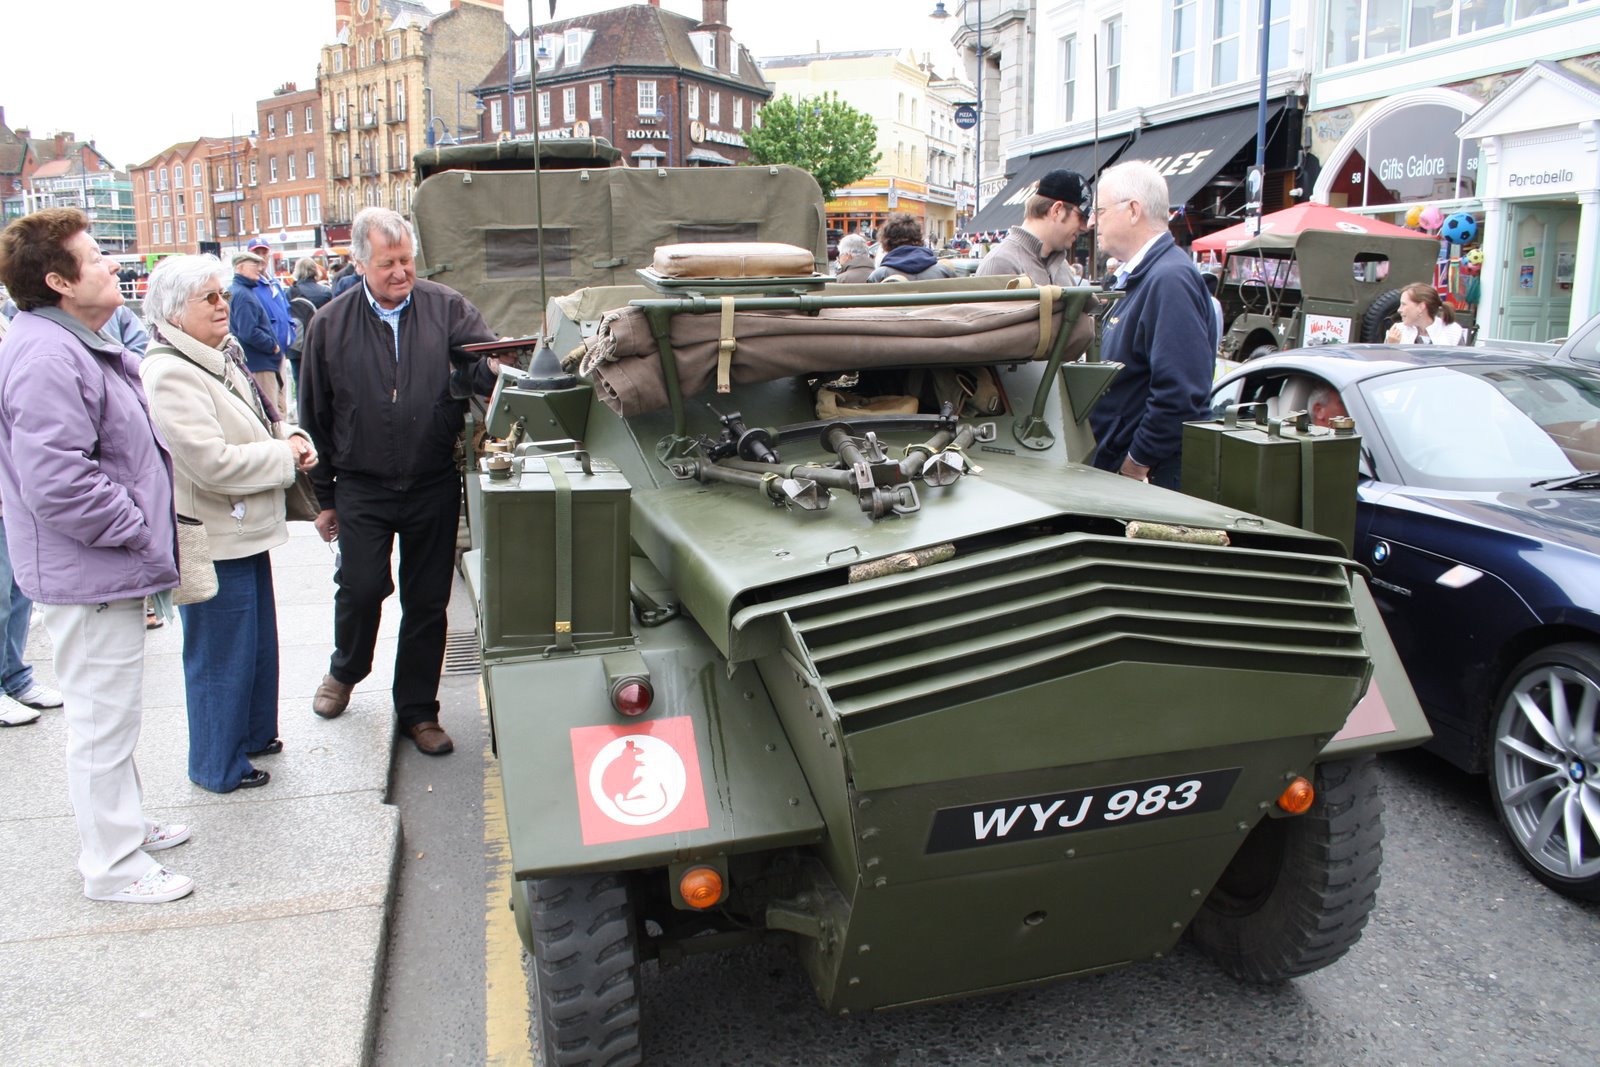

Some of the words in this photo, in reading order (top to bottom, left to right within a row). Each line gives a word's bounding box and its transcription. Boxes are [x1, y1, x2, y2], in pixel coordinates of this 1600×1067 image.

[627, 129, 669, 139] ROYAL
[1145, 149, 1214, 176] ILES
[1379, 158, 1404, 181] Gifts
[1406, 154, 1444, 178] Galore
[1466, 157, 1478, 170] 58
[1351, 172, 1362, 184] 58
[1509, 168, 1573, 187] Portobello
[973, 795, 1093, 840] WYJ
[1103, 780, 1202, 821] 983
